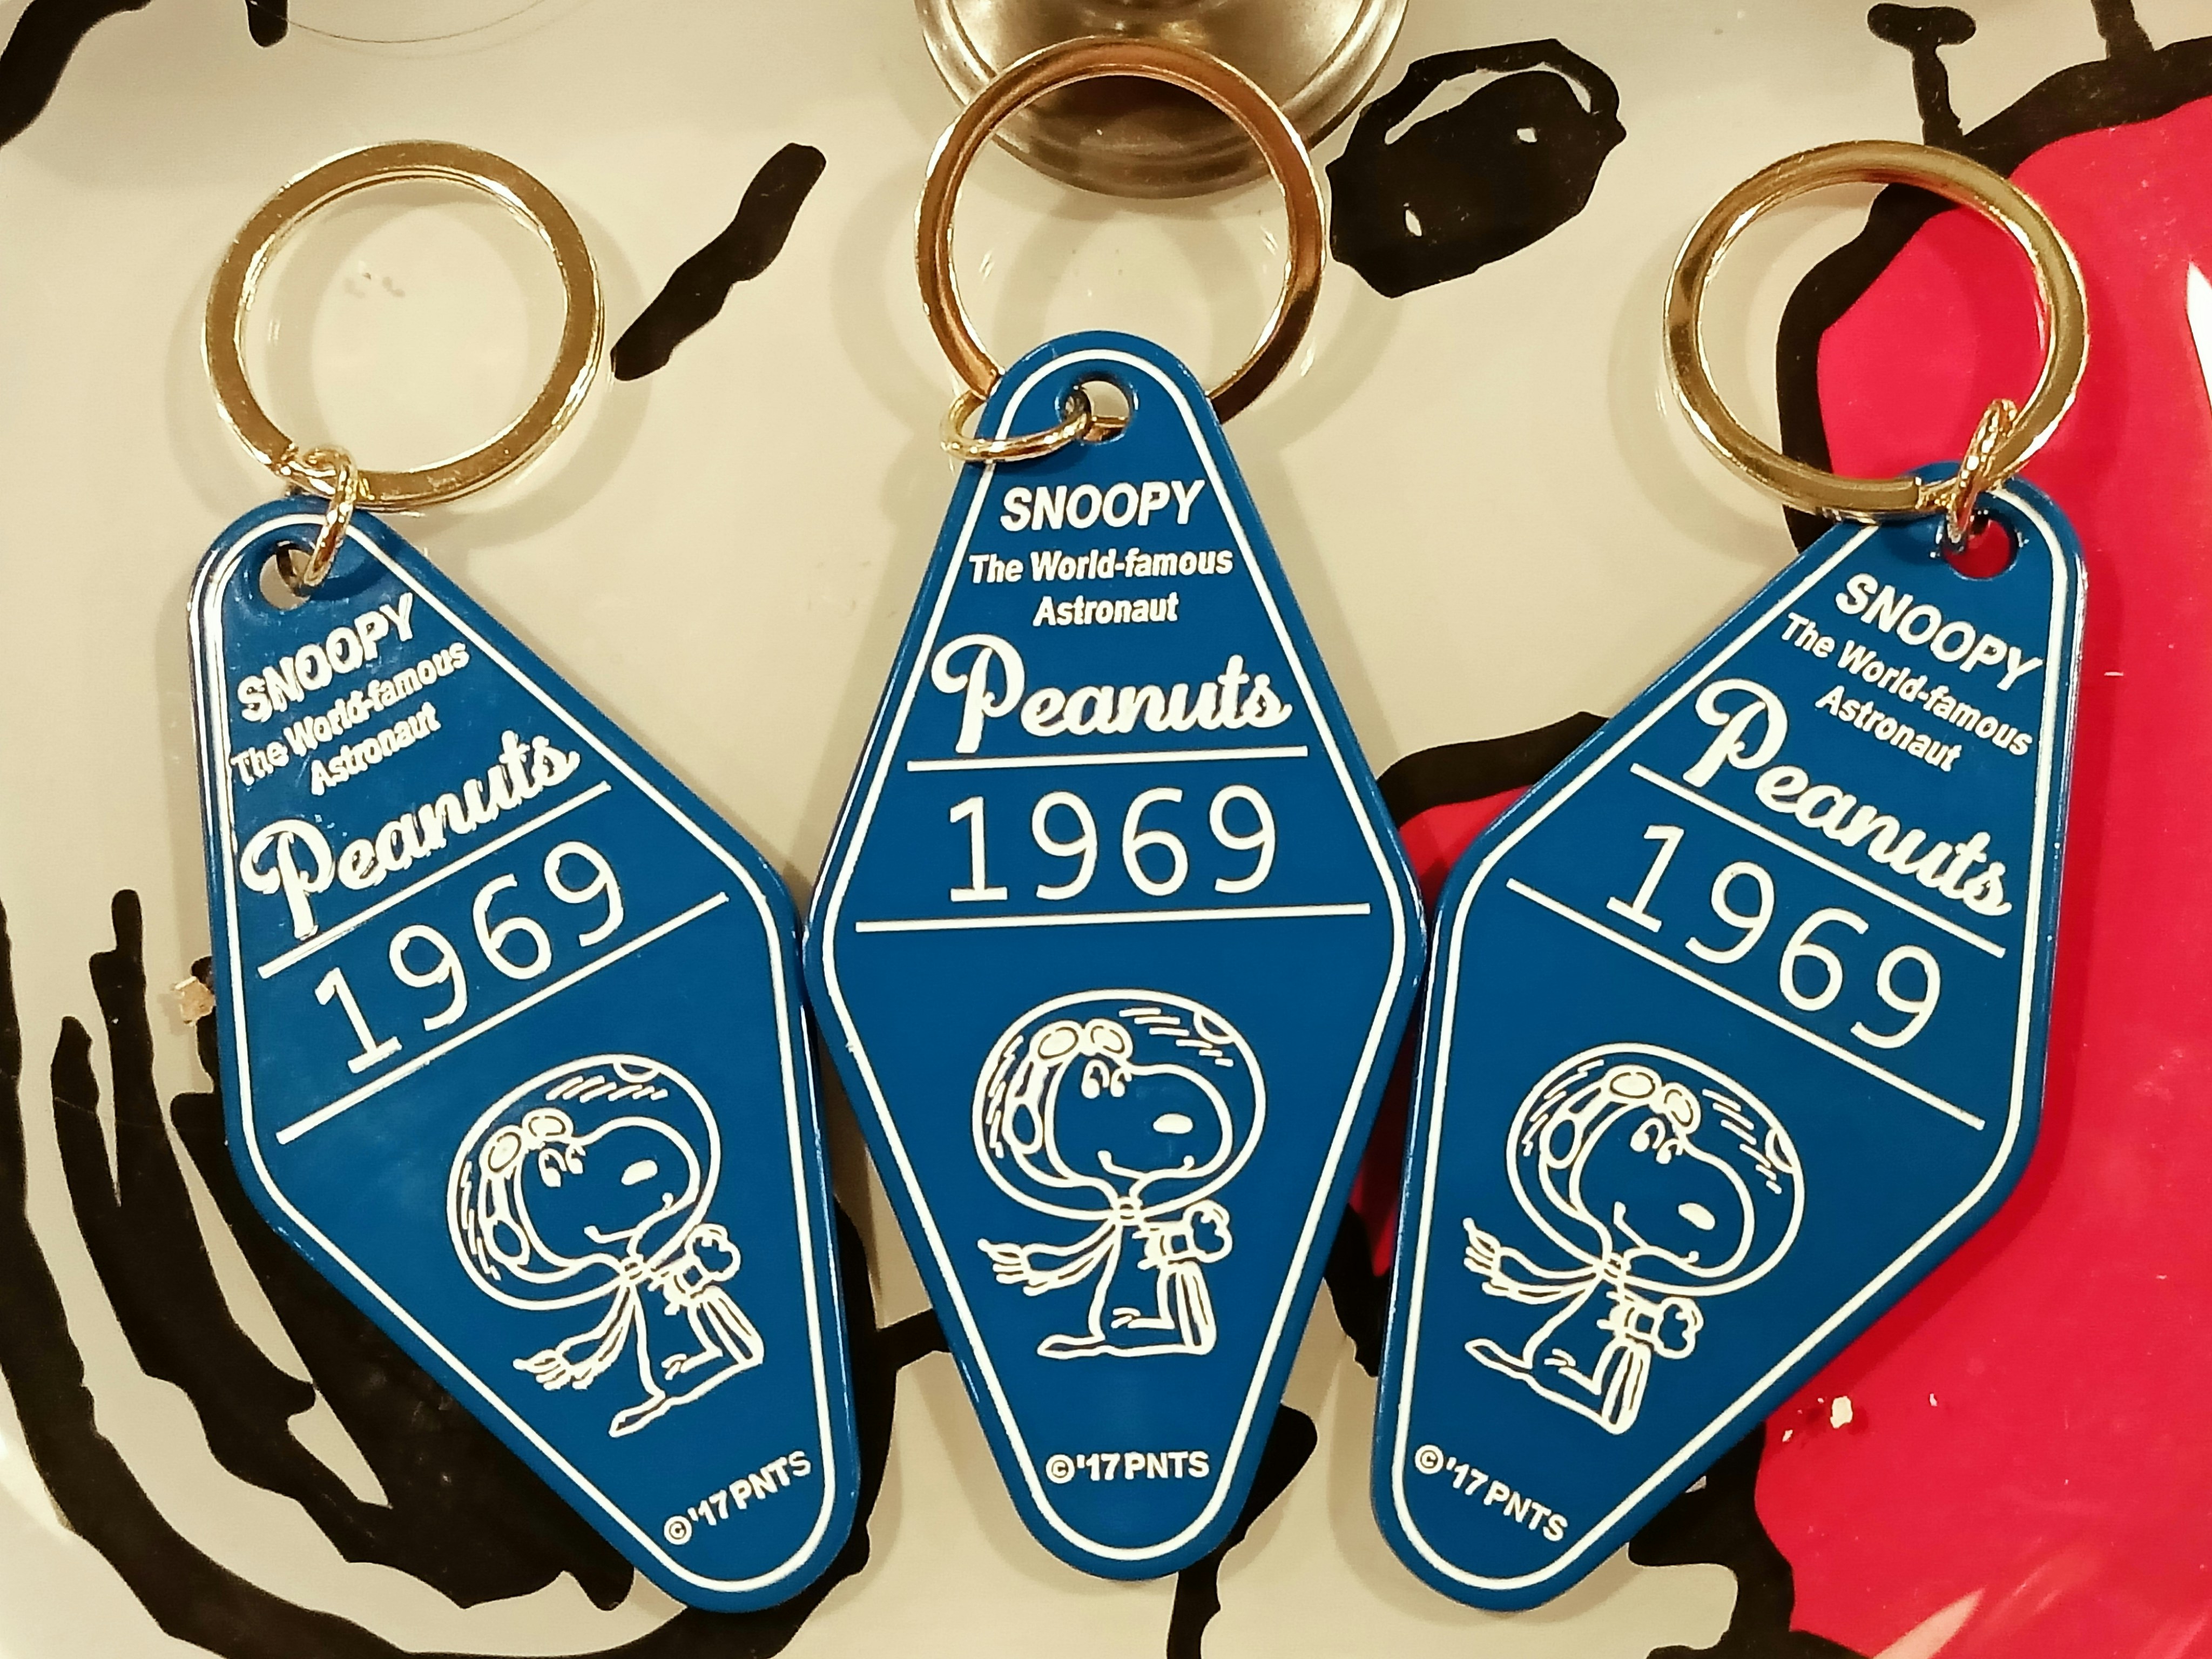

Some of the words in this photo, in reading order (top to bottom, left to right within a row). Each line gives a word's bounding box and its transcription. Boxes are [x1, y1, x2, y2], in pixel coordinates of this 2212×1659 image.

[1001, 480, 1205, 531] SNOOPY
[969, 554, 1023, 583] The
[1030, 548, 1232, 581] World-famous
[1033, 592, 1178, 626] Astronaut
[238, 593, 413, 722] SNOOPY
[1783, 612, 1835, 657] The
[1838, 640, 2032, 755] World-famous
[1836, 574, 2042, 690] SNOOPY
[233, 744, 284, 785] The
[285, 643, 469, 756] World-famous
[312, 702, 441, 795] Astronaut
[932, 635, 1292, 751] Peanuts
[1816, 686, 1961, 771] Astronaut
[240, 732, 580, 939] Peanuts
[950, 785, 1275, 901] 1969
[1685, 679, 2012, 914] Peanuts
[315, 842, 623, 1073] 1969
[1607, 826, 1940, 1048] 1969
